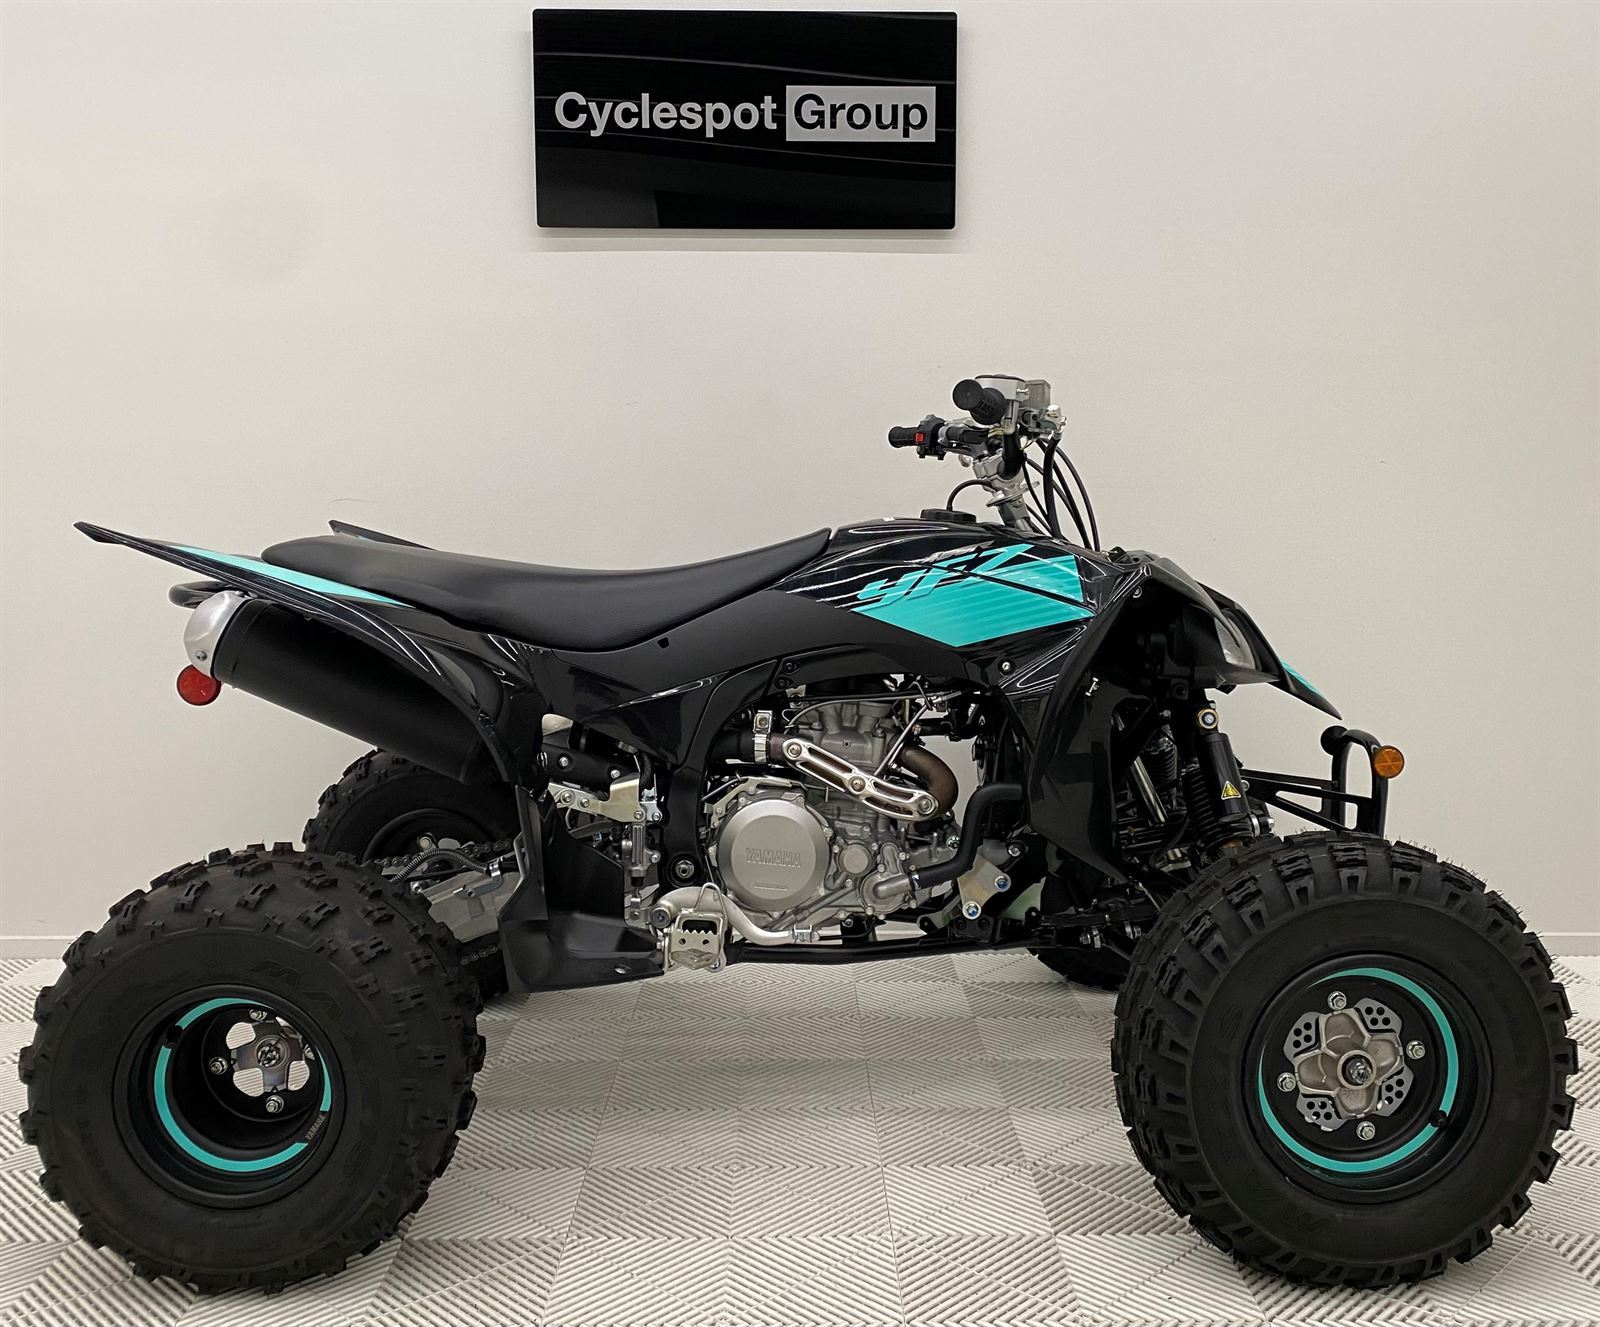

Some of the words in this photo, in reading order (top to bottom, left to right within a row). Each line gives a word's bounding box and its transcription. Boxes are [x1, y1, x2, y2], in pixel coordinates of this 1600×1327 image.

[555, 91, 777, 138] Cyclespot
[793, 93, 928, 138] Group
[745, 847, 801, 868] YAMAHA
